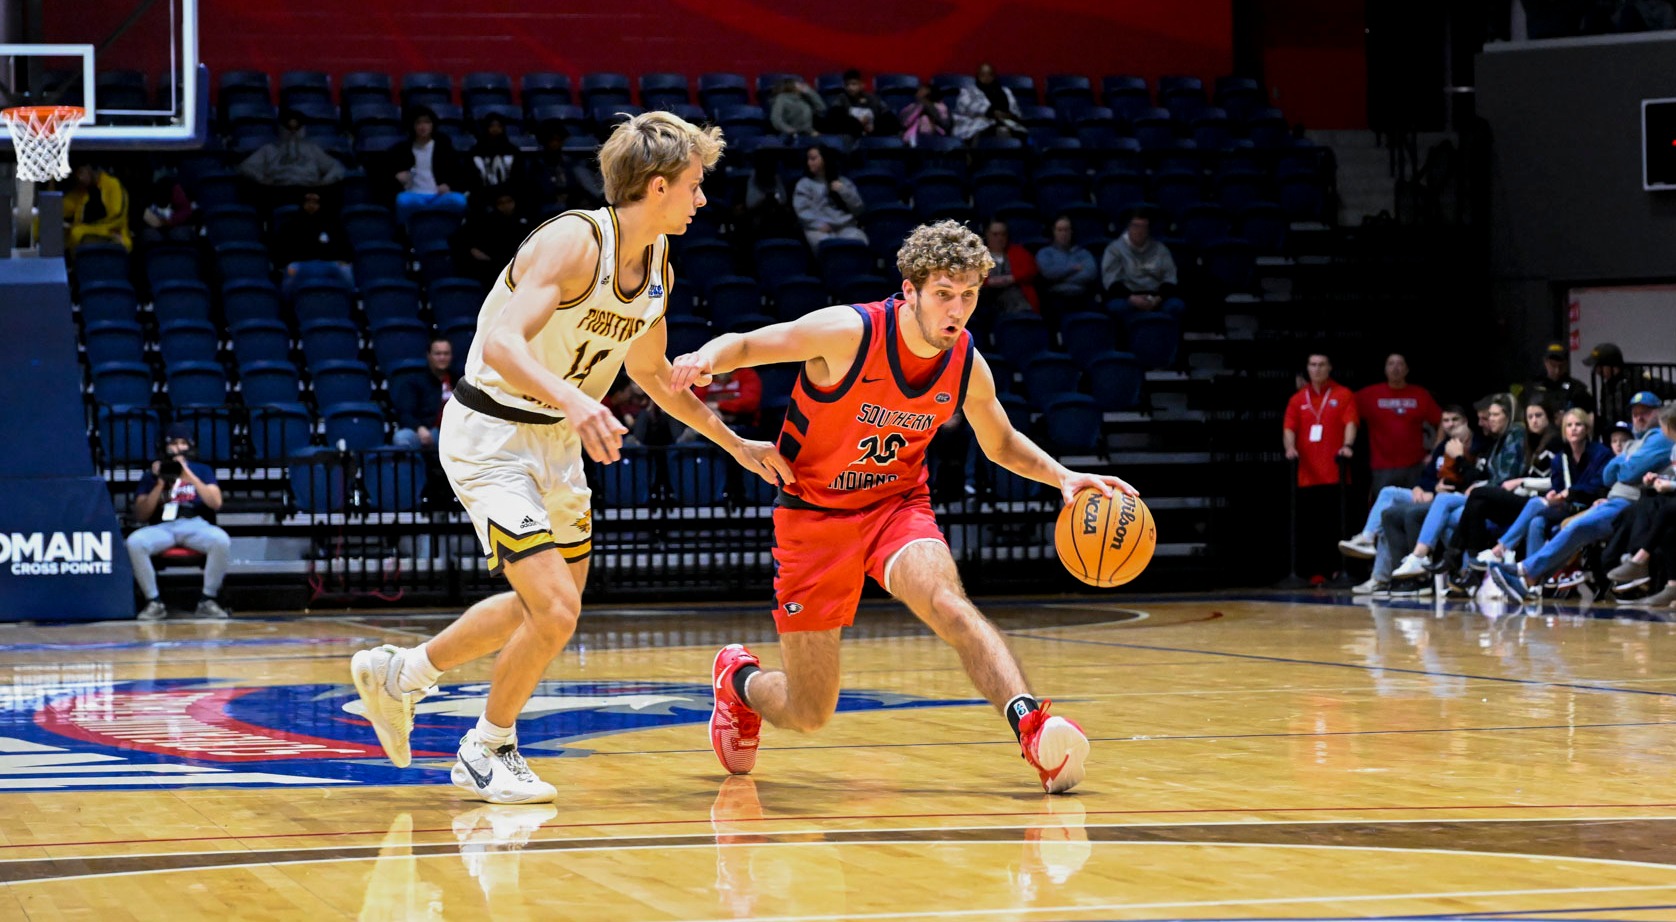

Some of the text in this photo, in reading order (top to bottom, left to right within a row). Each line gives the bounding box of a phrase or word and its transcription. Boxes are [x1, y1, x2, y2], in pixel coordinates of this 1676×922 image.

[856, 402, 936, 431] SOUTHERN
[848, 432, 909, 466] 20
[1083, 493, 1103, 535] NCAA
[1110, 491, 1136, 551] Wilson
[11, 561, 113, 575] CROSS POINTE
